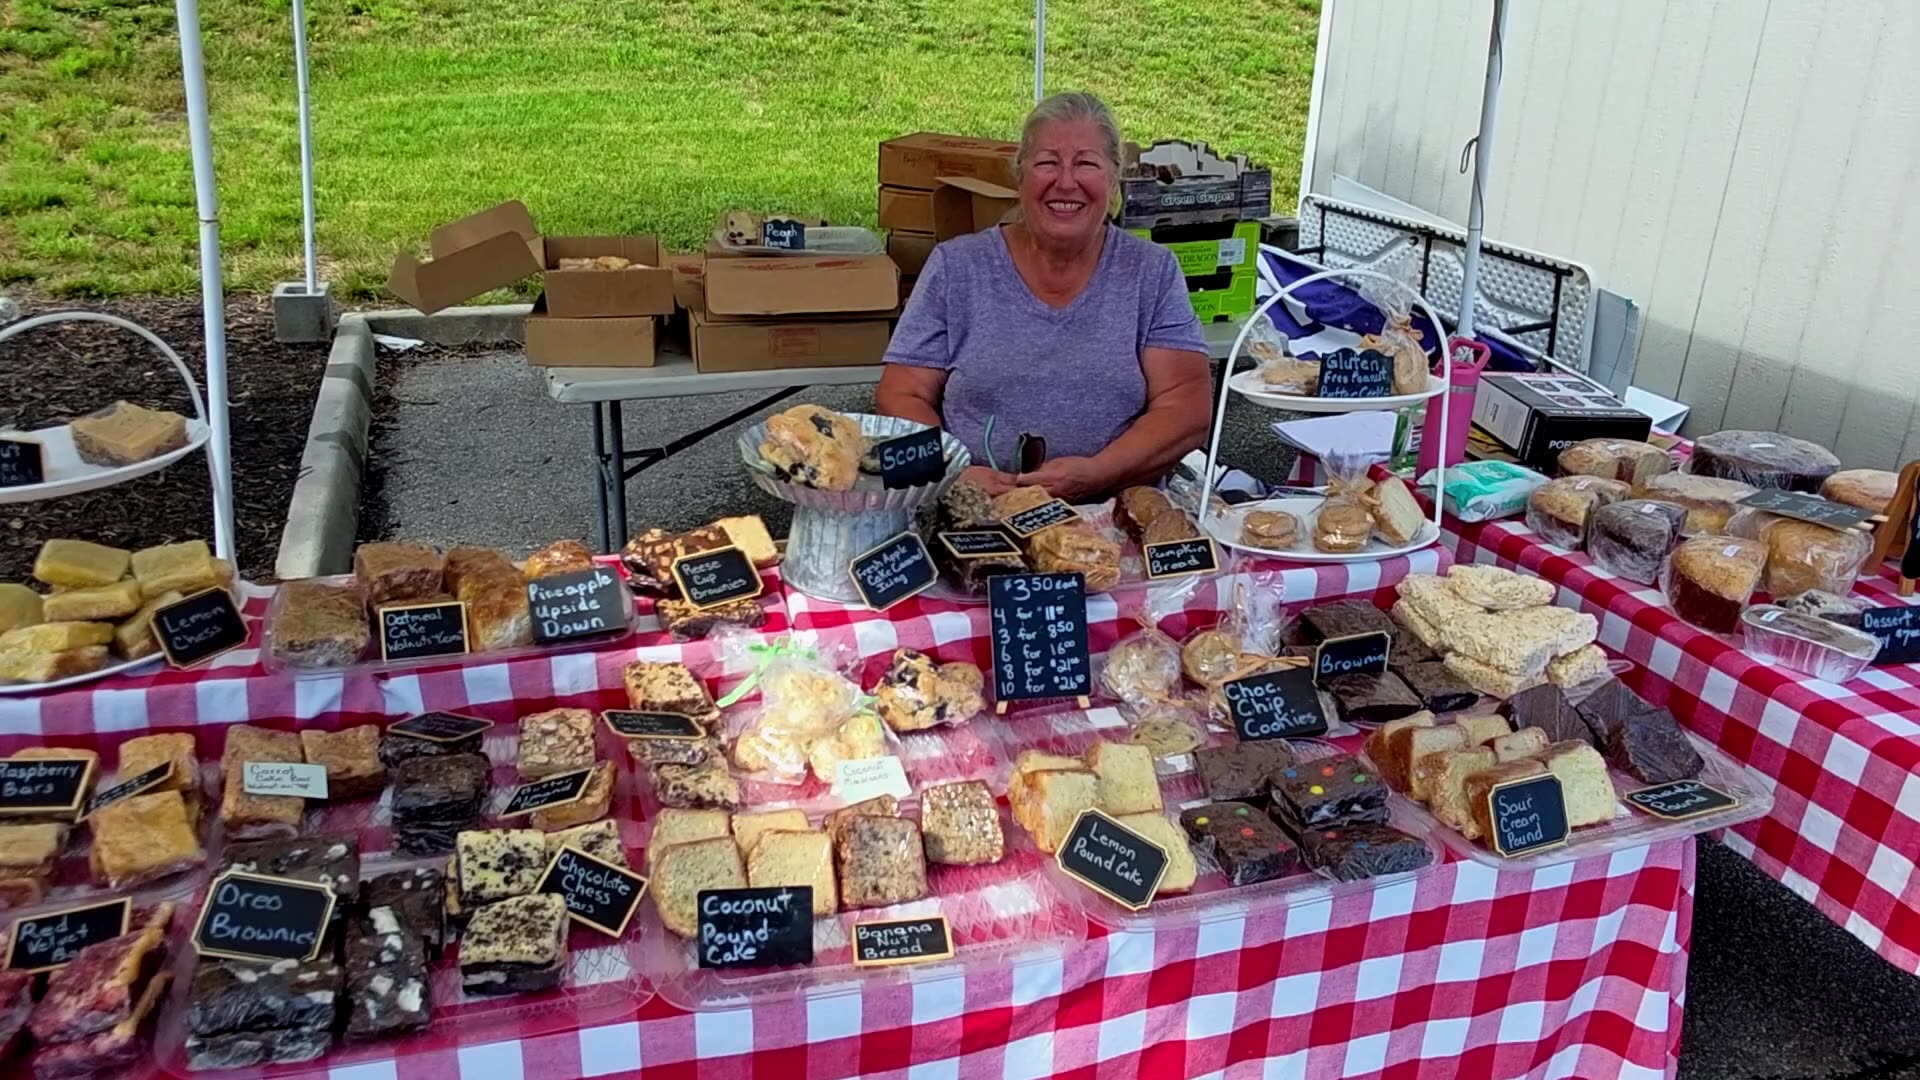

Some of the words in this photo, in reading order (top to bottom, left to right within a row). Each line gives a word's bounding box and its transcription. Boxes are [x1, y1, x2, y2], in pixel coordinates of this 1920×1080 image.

[1160, 193, 1195, 207] Green
[1196, 190, 1235, 206] Grapes
[766, 223, 798, 237] Peach
[1183, 252, 1218, 263] DRAGON
[1326, 352, 1379, 371] Gluten
[1323, 370, 1349, 384] Free
[1352, 366, 1388, 384] Peanut
[883, 440, 941, 471] Scones
[1148, 543, 1208, 558] Pumpkin
[681, 560, 722, 576] Reese
[1152, 555, 1201, 574] Bread
[528, 570, 614, 602] Pineapple
[693, 573, 717, 586] Cup
[867, 569, 893, 587] Cake
[690, 578, 747, 601] Brownies
[386, 607, 443, 626] Oatmeal
[535, 597, 601, 620] Upside
[994, 608, 1007, 625] 4
[1016, 606, 1033, 619] for
[162, 606, 226, 634] Lemon
[543, 617, 606, 637] Down
[1864, 609, 1914, 629] Dessert
[172, 625, 223, 650] Chess
[389, 622, 427, 639] Cake
[998, 628, 1011, 644] 3
[1017, 627, 1038, 640] for
[1001, 645, 1012, 662] 6
[1023, 643, 1042, 659] for
[1003, 664, 1015, 680] 8
[1024, 661, 1044, 677] for
[1001, 681, 1015, 695] 10
[1025, 677, 1046, 693] for
[1225, 682, 1282, 700] Choc.
[1237, 696, 1285, 717] Chip
[1244, 709, 1318, 737] Cookies
[0, 762, 80, 783] Raspberry
[250, 763, 295, 776] Carrot
[2, 781, 55, 798] Bars
[1498, 794, 1533, 816] Sour
[1650, 792, 1710, 812] Pound
[1500, 812, 1540, 832] Cream
[1089, 821, 1136, 860] Lemon
[1507, 821, 1543, 849] Pound
[1073, 836, 1116, 871] Pound
[1115, 861, 1144, 887] Cake
[557, 853, 631, 896] Chocolate
[217, 883, 283, 911] Oreo
[561, 874, 611, 905] Chess
[565, 892, 595, 914] Bars
[703, 887, 793, 915] Coconut
[18, 914, 69, 942] Red
[210, 912, 316, 945] Brownies
[703, 918, 769, 945] Pound
[857, 923, 932, 940] Banana
[864, 938, 923, 959] Bread
[877, 935, 909, 947] Nut
[706, 941, 757, 964] Cake
